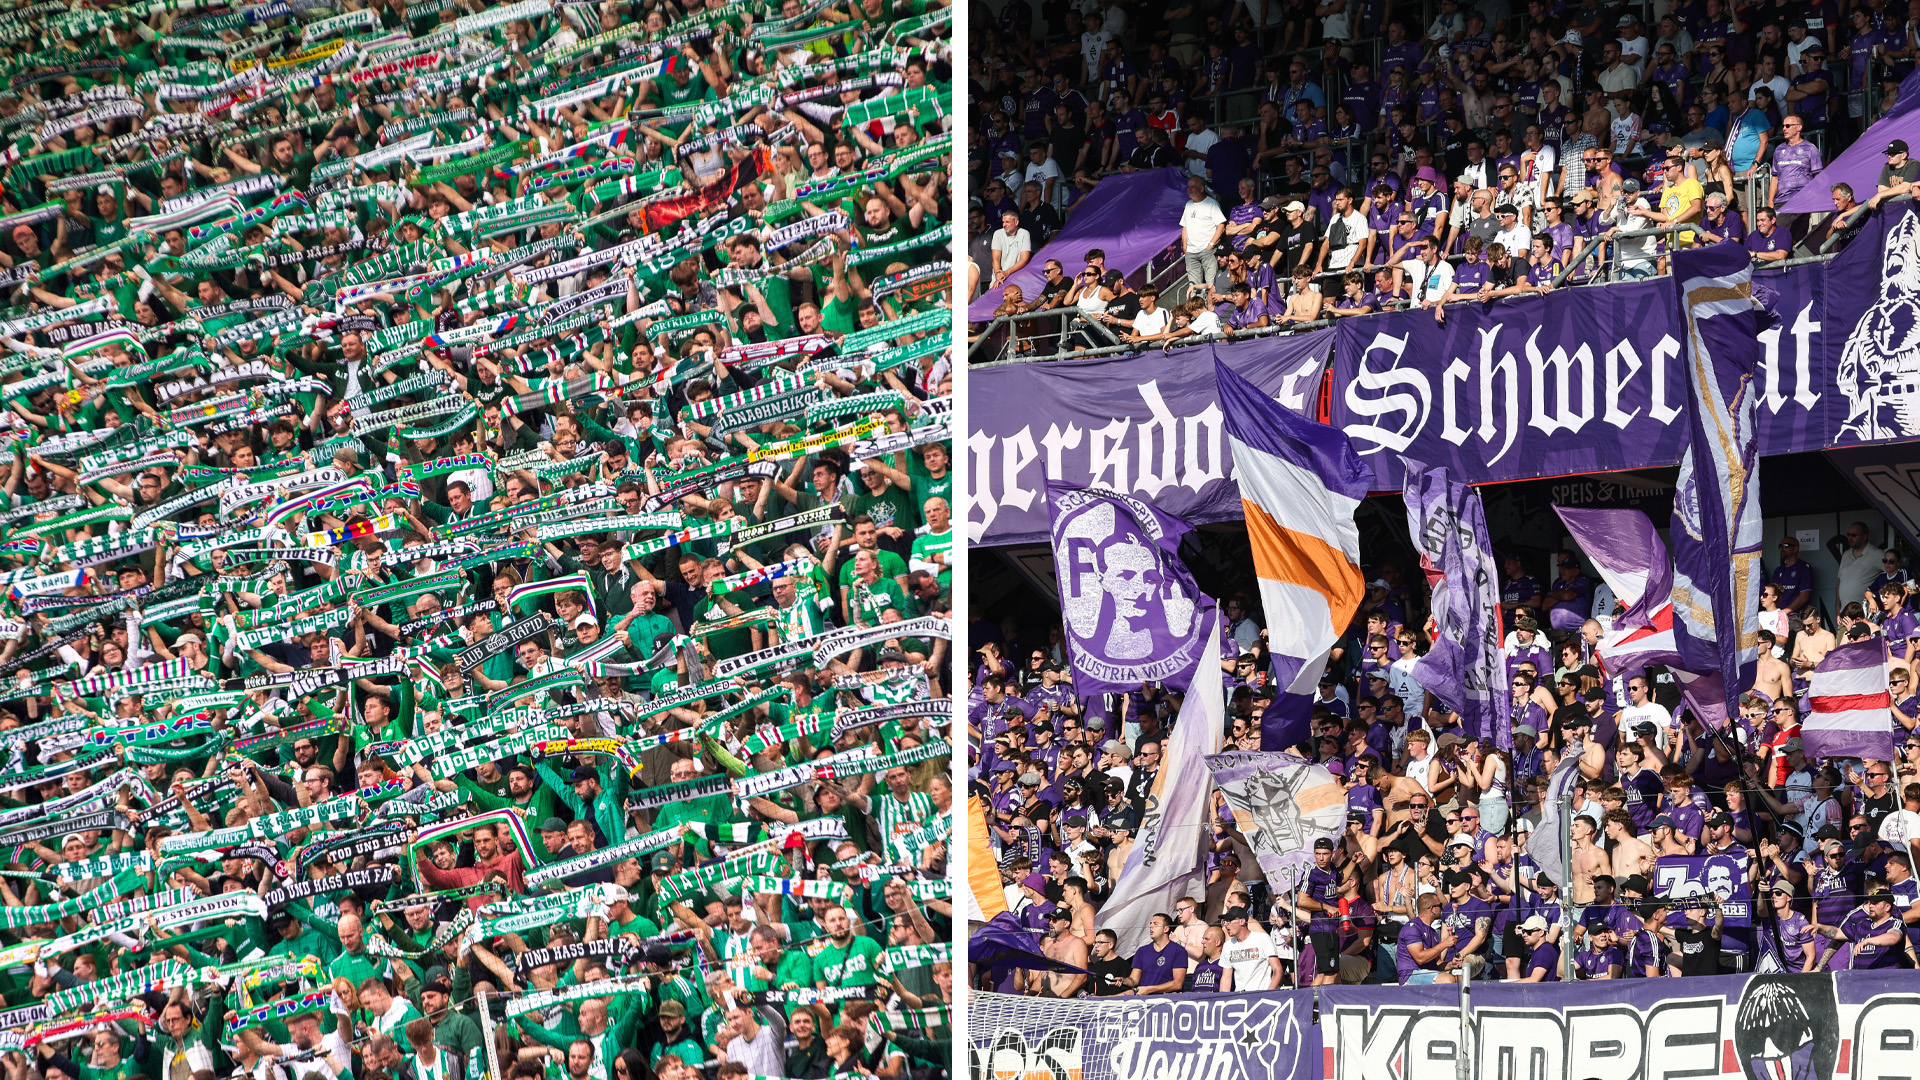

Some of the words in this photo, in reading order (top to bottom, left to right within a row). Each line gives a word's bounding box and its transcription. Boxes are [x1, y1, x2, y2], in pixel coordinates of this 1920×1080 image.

[353, 62, 398, 84] RAPID
[400, 52, 439, 73] WIEN
[383, 123, 403, 138] WIEN
[405, 117, 426, 133] WEST
[48, 326, 69, 345] TOD
[71, 322, 94, 342] UND
[95, 318, 123, 336] HASS
[878, 348, 903, 365] RAPID
[906, 340, 922, 353] IST
[1344, 298, 1823, 468] Schwecat
[171, 407, 203, 424] RAPID
[216, 396, 248, 413] WIEN
[348, 396, 371, 411] WIEN
[373, 385, 396, 401] WEST
[968, 355, 1322, 552] gersdof
[1551, 481, 1594, 506] SPEIS
[25, 579, 38, 594] SK
[41, 575, 71, 590] RAPID
[509, 617, 544, 640] RAPID
[719, 642, 788, 676] BLOCK
[1075, 652, 1138, 681] AUSTRIA
[1139, 651, 1186, 680] WIEN
[833, 761, 862, 779] WIEN
[865, 754, 894, 773] WEST
[629, 793, 647, 808] SK
[648, 782, 693, 806] RAPID
[256, 818, 274, 833] SK
[276, 808, 314, 829] RAPID
[318, 800, 353, 820] WIEN
[329, 845, 354, 862] TOD
[358, 836, 382, 854] UND
[385, 828, 413, 847] HASS
[601, 831, 673, 862] ANTIVIOLA
[112, 852, 148, 871] WIEN
[264, 890, 285, 908] TOD
[288, 883, 310, 903] UND
[313, 875, 344, 896] HASS
[347, 870, 373, 889] DEM
[71, 918, 135, 945] RAPID
[524, 952, 550, 969] UND
[554, 943, 586, 961] HASS
[589, 939, 621, 955] DEM
[765, 990, 785, 1004] SK
[1098, 1000, 1250, 1044] FAMOUS
